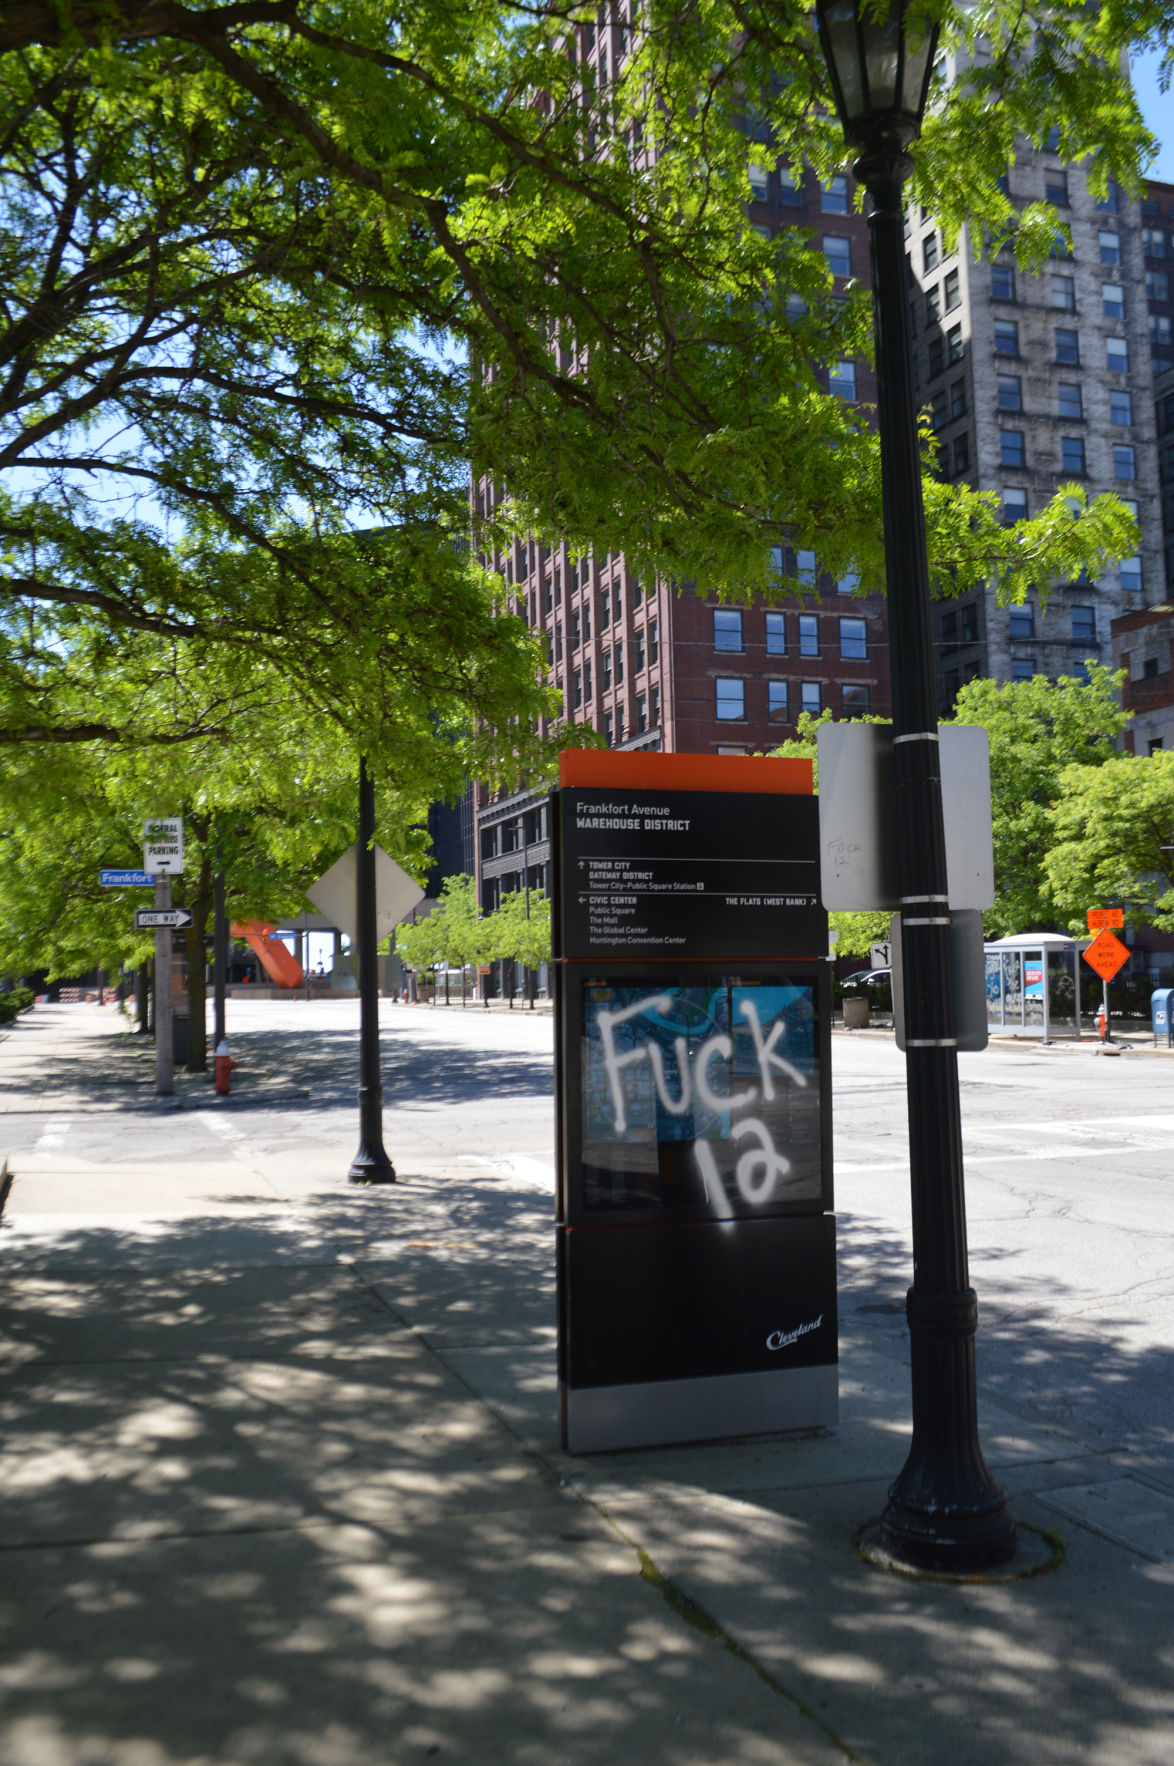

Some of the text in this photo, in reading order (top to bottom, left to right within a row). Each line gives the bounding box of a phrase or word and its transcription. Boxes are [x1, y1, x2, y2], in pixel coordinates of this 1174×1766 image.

[576, 802, 671, 815] Frankfort Avenue
[576, 818, 690, 831] WAREHOUSE DISTRICT
[147, 846, 179, 856] PARKING
[589, 861, 631, 870] TOWER CITY
[101, 873, 153, 884] Frankfort
[588, 872, 654, 880] GATEWAY DISTRICT
[589, 881, 610, 889] Tower
[648, 883, 673, 891] Square
[589, 896, 637, 905] CIVIC CENTER
[725, 897, 807, 906] THE FLATS (WEST BANK)
[589, 906, 636, 915] Public Square
[141, 914, 180, 924] ONE WAY
[589, 916, 618, 924] The Mall
[589, 926, 648, 935] The Global Center
[590, 936, 687, 945] Huntington Convention Center
[597, 995, 808, 1138] FUCK
[765, 1313, 824, 1351] Cleveland
